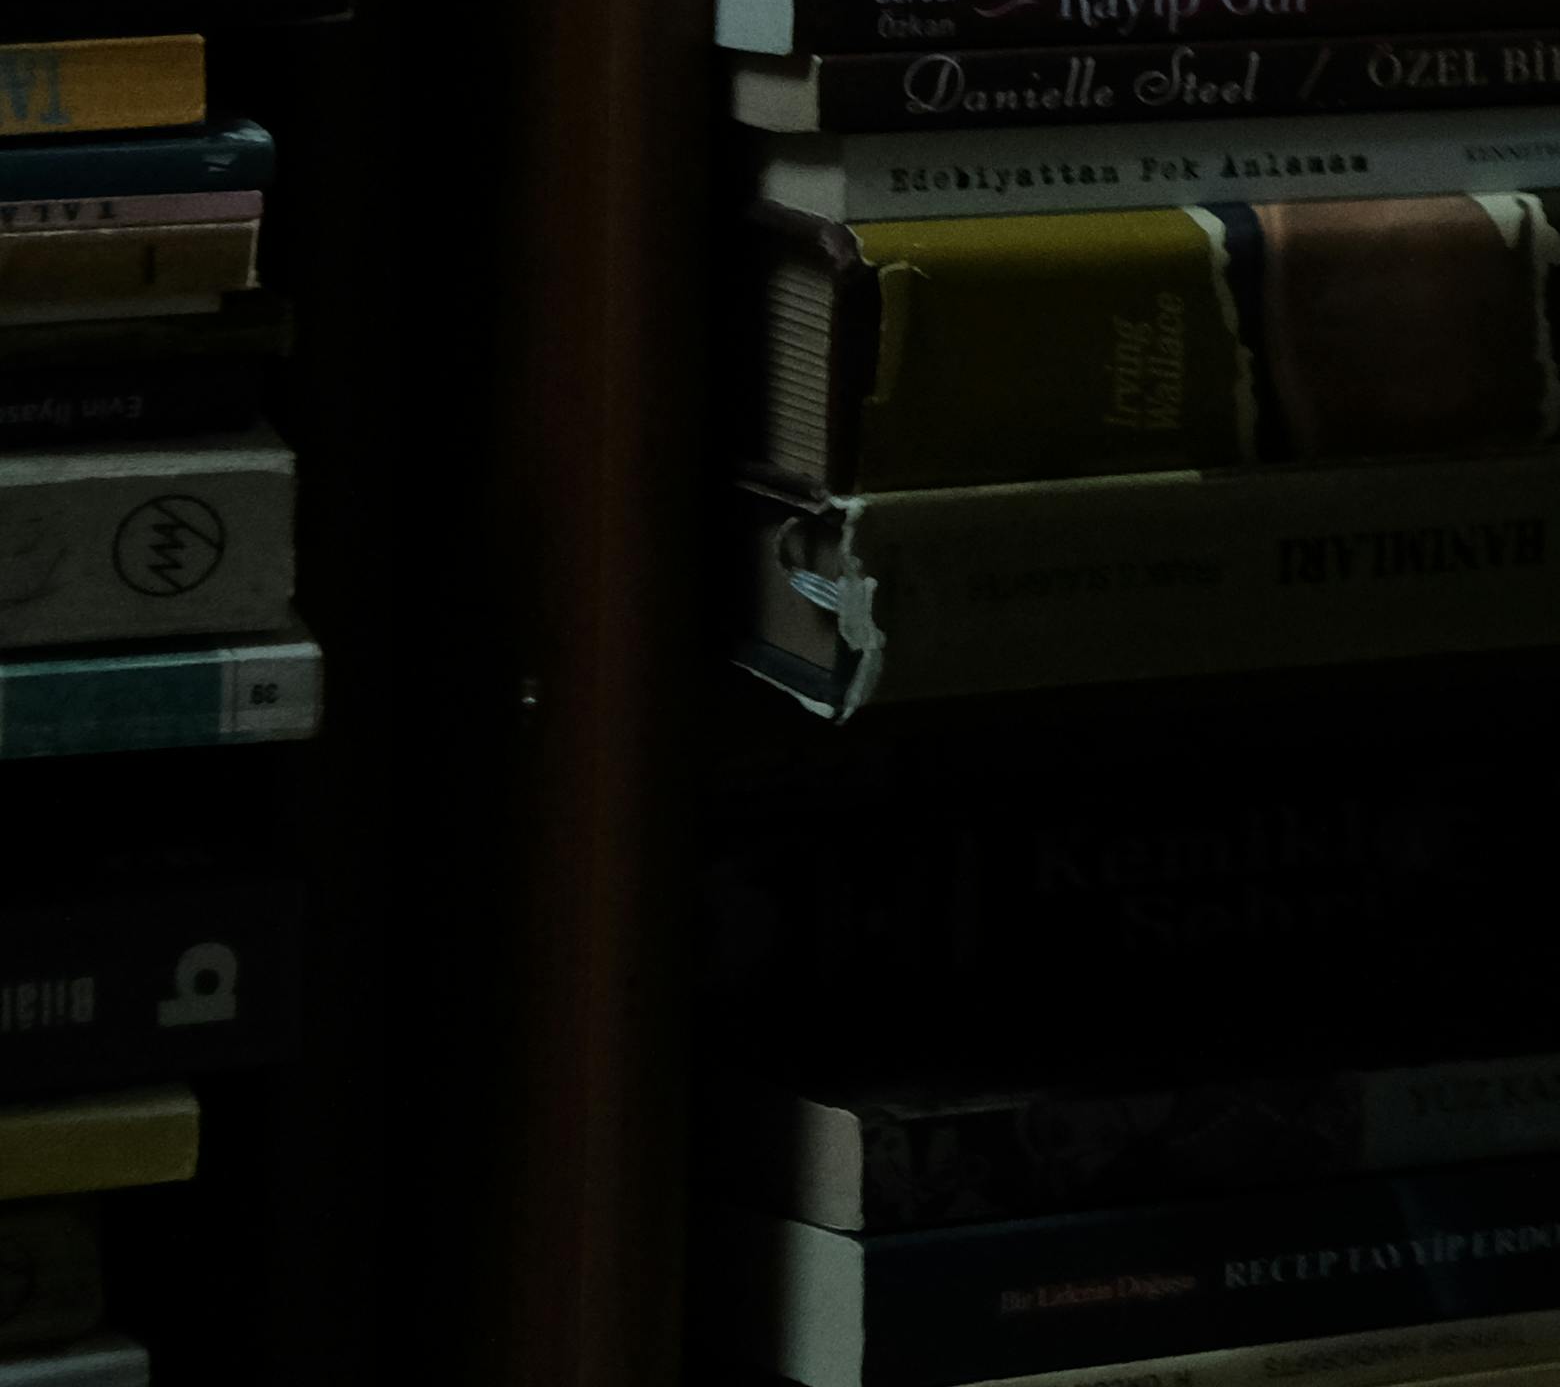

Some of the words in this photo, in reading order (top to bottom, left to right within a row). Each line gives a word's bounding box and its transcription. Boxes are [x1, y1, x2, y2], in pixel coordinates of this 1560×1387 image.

[903, 47, 1116, 117] Danielle
[1134, 44, 1259, 108] Steel
[1367, 39, 1488, 91] ÖZEL
[1224, 1251, 1342, 1291] RECEP
